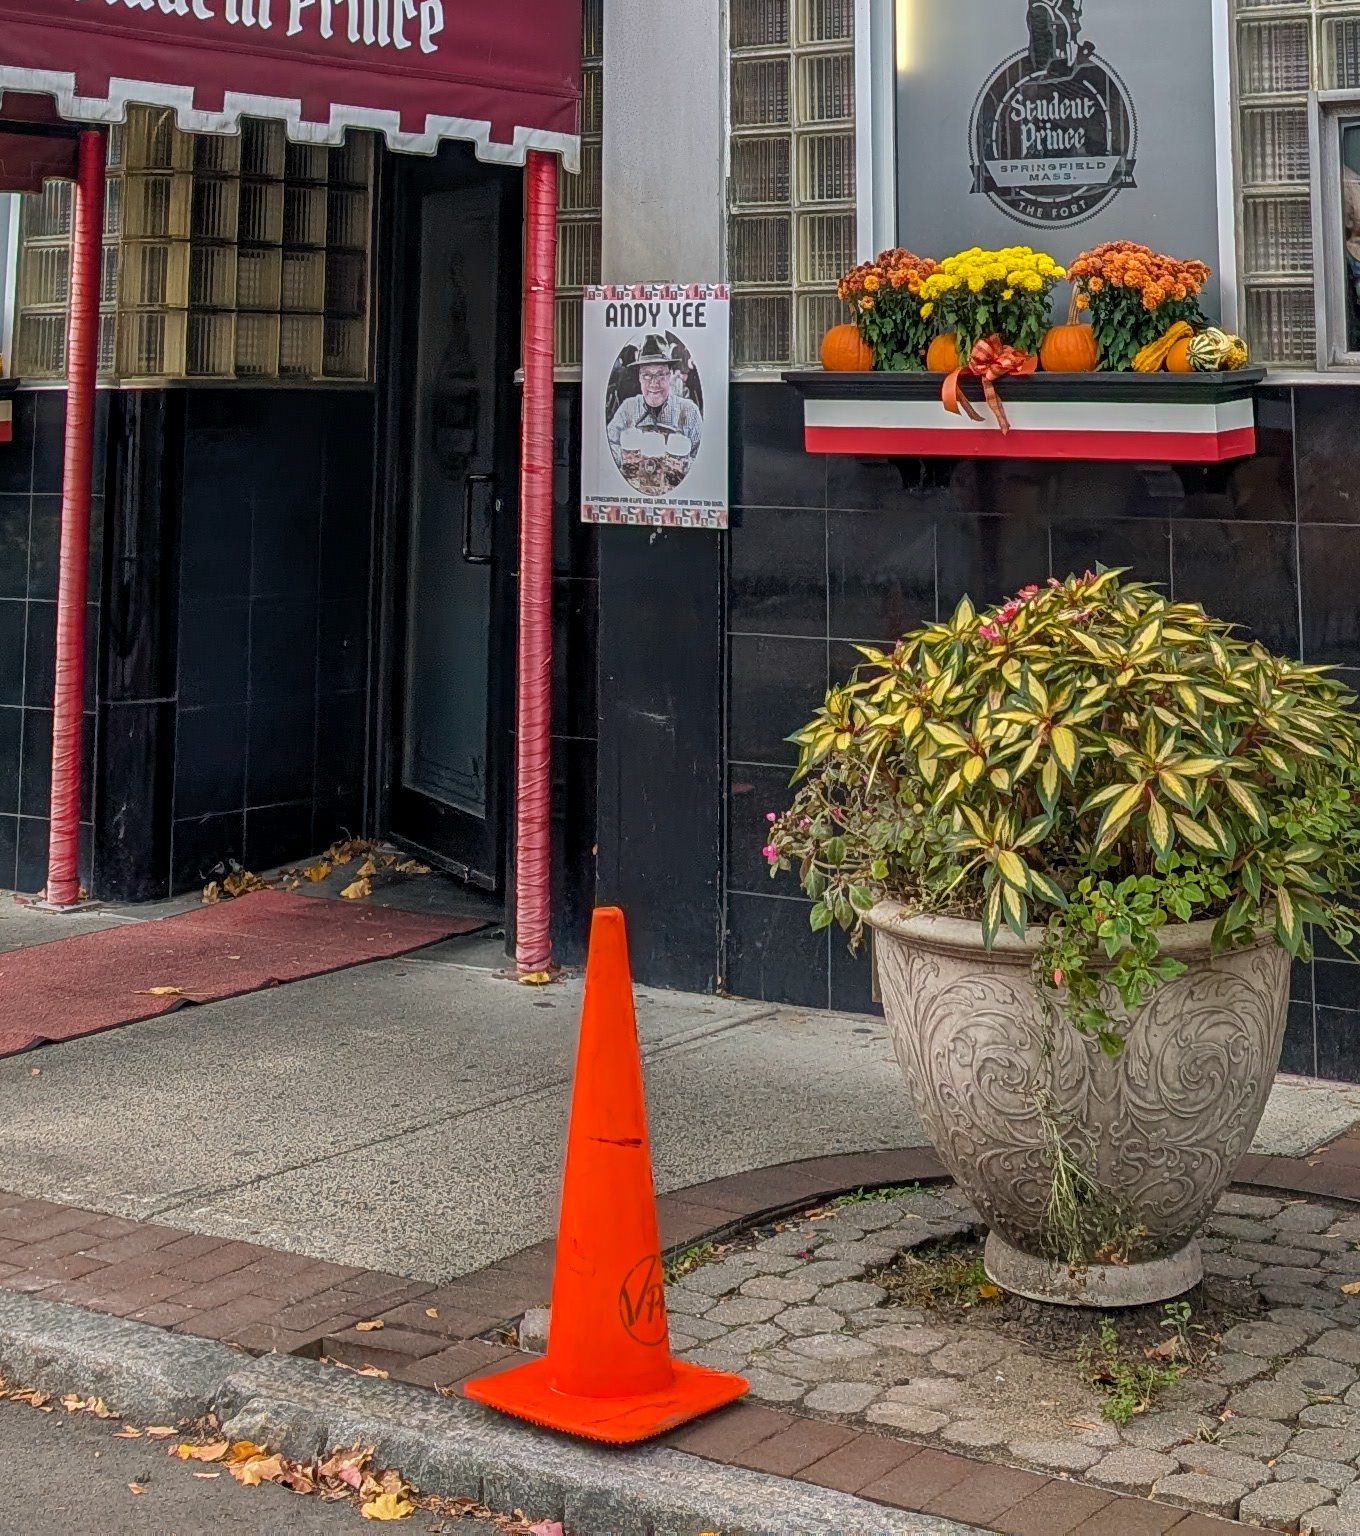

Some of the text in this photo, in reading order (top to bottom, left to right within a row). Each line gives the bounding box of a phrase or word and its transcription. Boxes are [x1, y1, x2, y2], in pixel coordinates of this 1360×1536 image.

[1010, 92, 1095, 121] Student
[1021, 122, 1086, 158] Prince
[1000, 161, 1106, 174] SPRINGFIELD
[1028, 173, 1078, 182] MASS.
[1017, 200, 1087, 218] THE FORT
[605, 302, 707, 328] ANDY YEE
